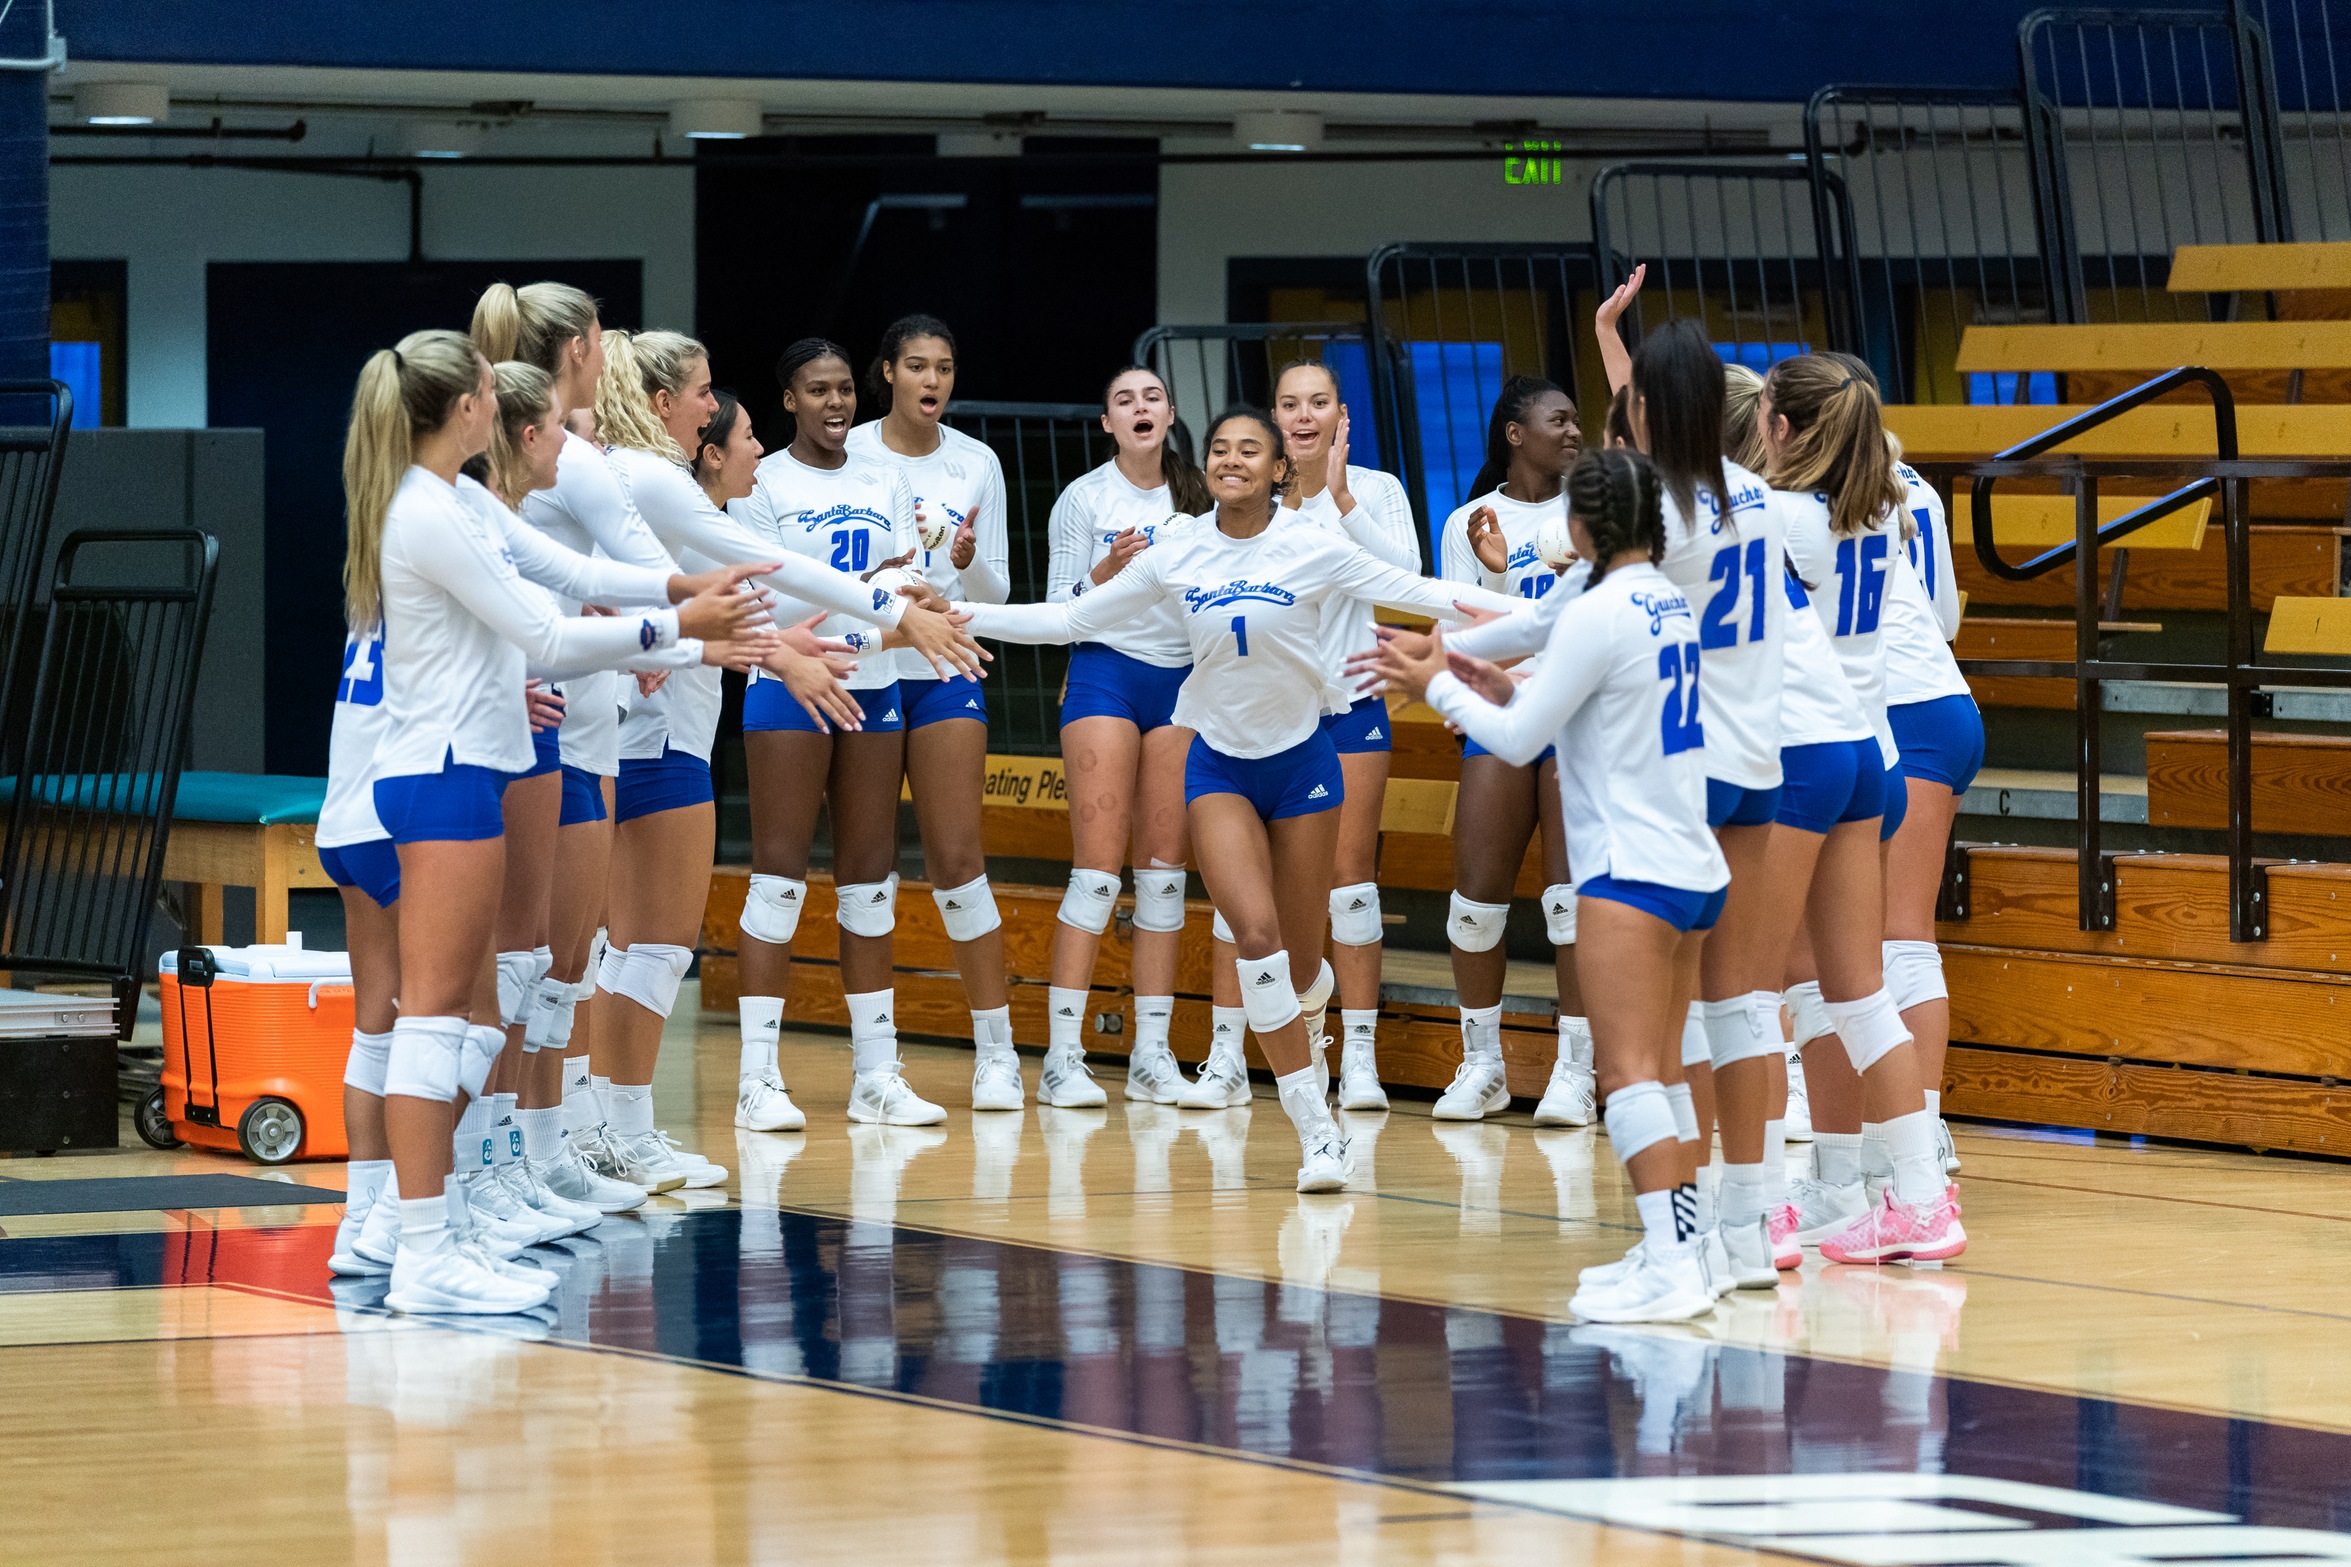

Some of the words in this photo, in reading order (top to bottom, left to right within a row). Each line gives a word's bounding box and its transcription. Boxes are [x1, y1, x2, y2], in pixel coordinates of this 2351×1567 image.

[830, 528, 870, 573] 20
[1700, 538, 1766, 650] 21
[1835, 534, 1888, 637] 16
[1231, 616, 1249, 656] 1
[1659, 641, 1705, 757] 22
[1036, 770, 1068, 800] Ple
[1999, 789, 2011, 815] C
